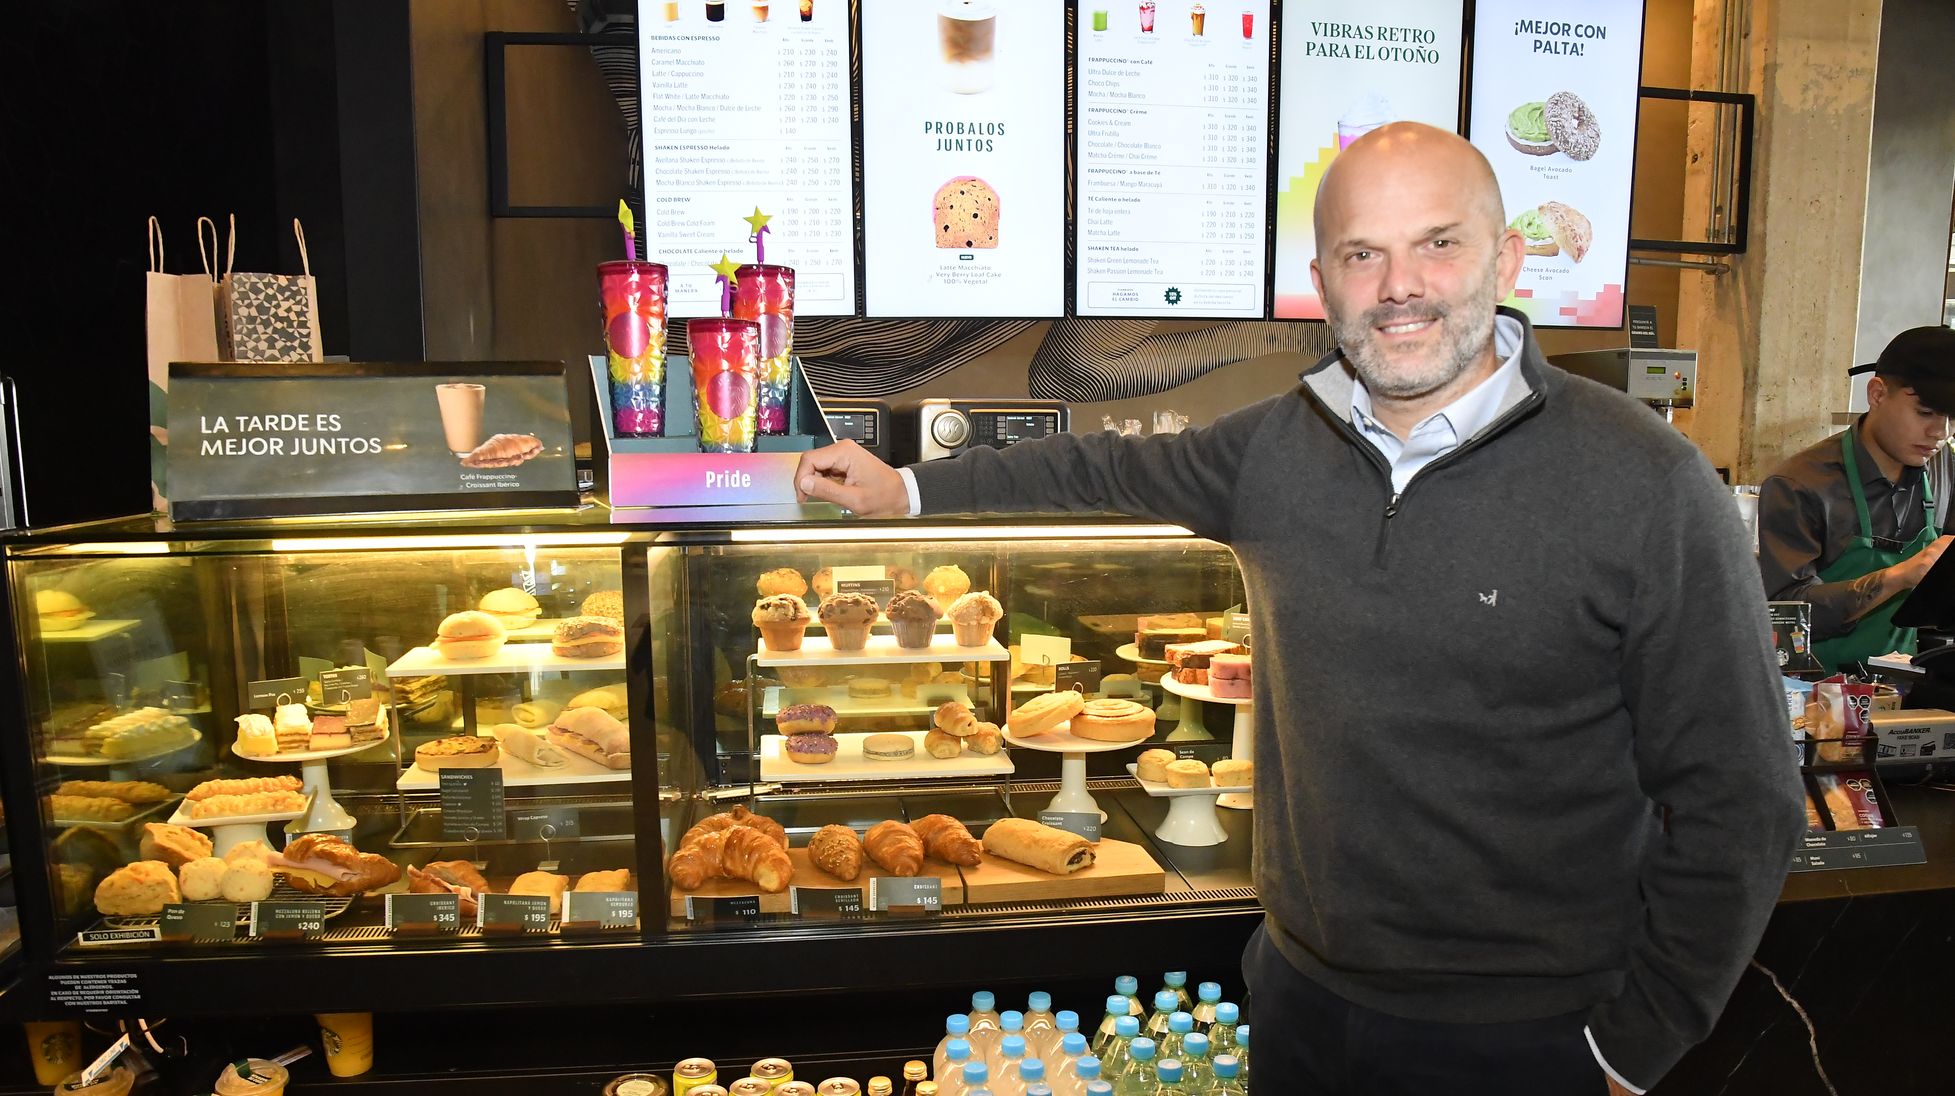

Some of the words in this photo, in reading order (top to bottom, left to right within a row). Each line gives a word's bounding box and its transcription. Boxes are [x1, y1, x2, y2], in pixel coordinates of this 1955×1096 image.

[1311, 21, 1373, 40] VIBRAS
[1378, 25, 1435, 43] RETRO
[1515, 20, 1571, 37] ¡MEJOR
[1574, 24, 1606, 39] CON
[1306, 41, 1350, 58] PARA
[1354, 45, 1375, 60] EL
[1378, 46, 1439, 64] OTOÑO
[1534, 39, 1584, 56] PALTA!
[925, 121, 1005, 135] PROBALOS
[937, 138, 993, 152] JUNTOS
[201, 415, 229, 433] LA
[235, 414, 310, 432] TARDE
[316, 414, 341, 432] ES
[201, 438, 283, 456] MEJOR
[290, 437, 382, 456] JUNTOS
[705, 470, 751, 489] Pride
[298, 922, 320, 930] $240
[531, 914, 545, 922] 195
[110, 930, 150, 940] EXHIBICIÓN
